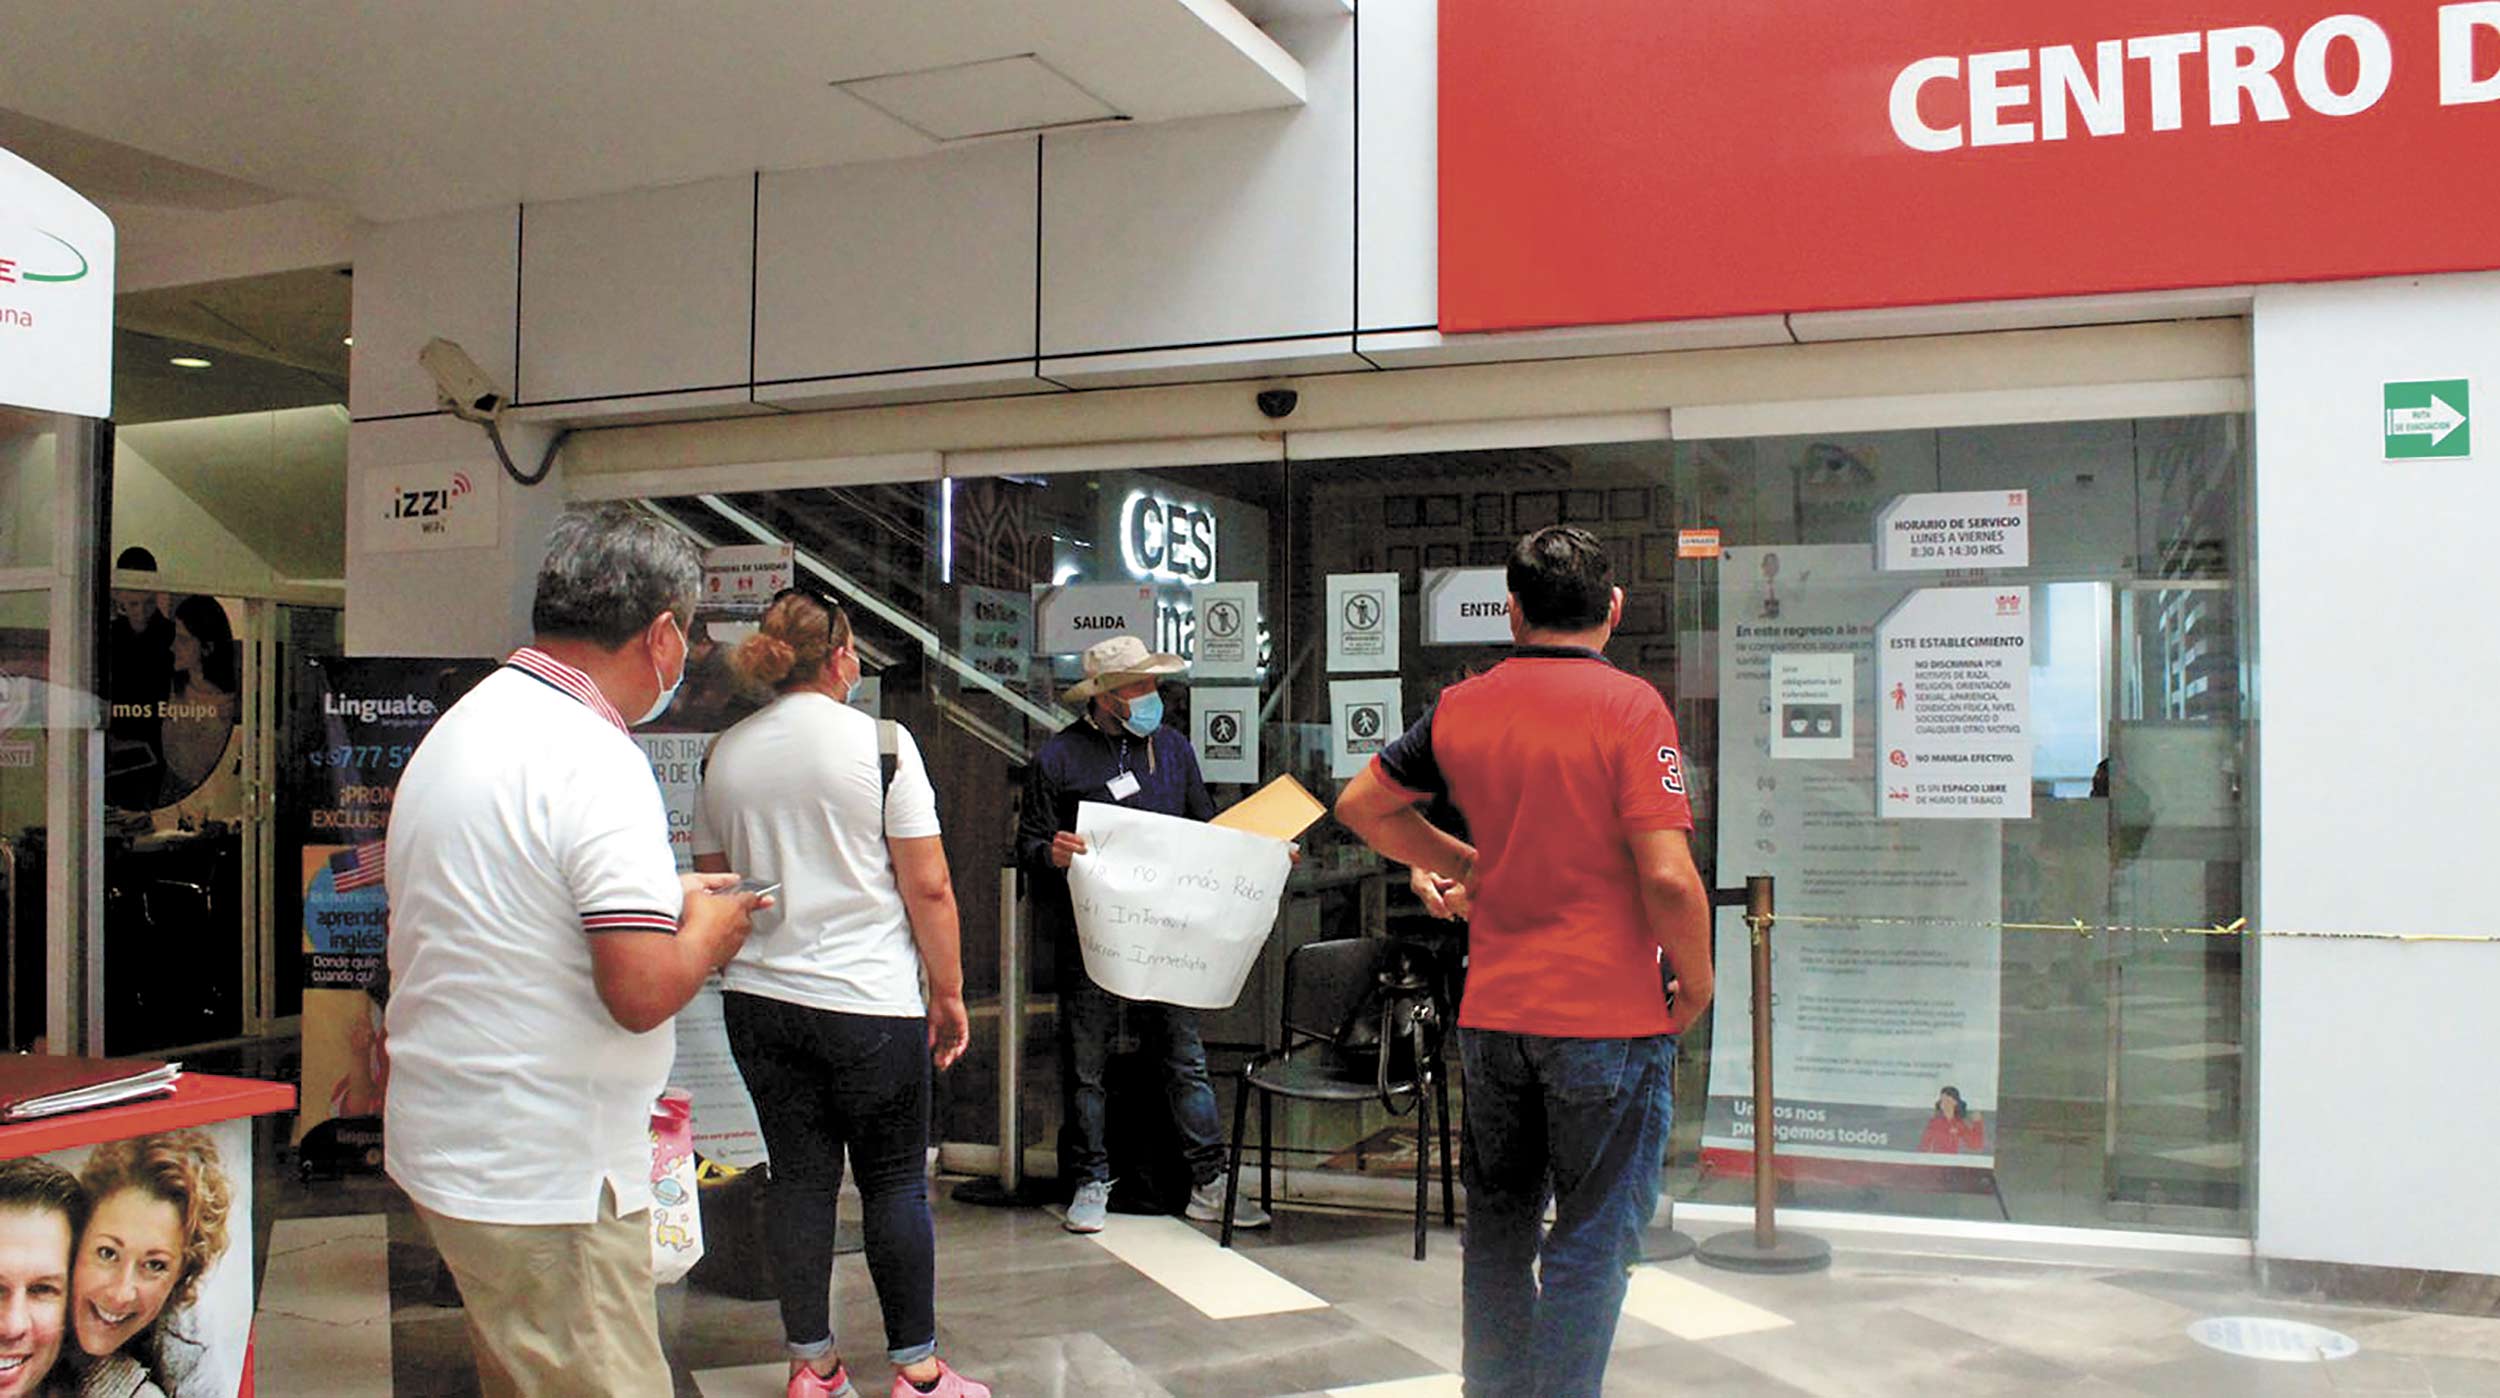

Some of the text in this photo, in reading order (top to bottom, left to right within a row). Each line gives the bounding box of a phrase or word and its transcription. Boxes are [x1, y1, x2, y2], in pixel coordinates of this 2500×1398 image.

[1888, 14, 2392, 152] CENTRO
[2411, 410, 2431, 418] RUTA
[2395, 424, 2404, 432] DE
[1894, 517, 2021, 531] HORARIO DE SERVICIO
[1131, 496, 1214, 580] CES
[1910, 531, 2004, 544] LUNES A VIERNES
[1911, 545, 1934, 557] 8:30
[1936, 546, 1945, 556] A
[1949, 545, 1978, 556] 14:30
[1073, 615, 1126, 630] SALIDA
[1736, 625, 1752, 638] En
[1754, 626, 1781, 636] este
[1783, 627, 1834, 638] regreso
[1890, 636, 2024, 649] ESTE ESTABLECIMIENTO
[1915, 660, 2002, 669] NO DISCRIMINA POR
[1915, 671, 1951, 680] MOTIVOS
[1954, 671, 1964, 680] DE
[158, 701, 217, 722] Equipo
[1992, 704, 2015, 712] NIVEL
[1915, 725, 1961, 735] CUALQUIER
[1963, 725, 1984, 734] OTRO
[1915, 754, 2014, 763] NO MANEJA EFECTIVO.
[1658, 746, 1685, 794] 3
[1915, 784, 1926, 793] ES
[1942, 784, 1980, 793] ESPACIO
[1982, 784, 2007, 793] LIBRE
[1915, 796, 1926, 805] DE
[1929, 796, 1955, 805] HUMO
[1957, 796, 1969, 805] DE
[1133, 865, 1157, 882] no
[1733, 1101, 1827, 1122] Unos nos
[1732, 1121, 1888, 1145] prgemos todos
